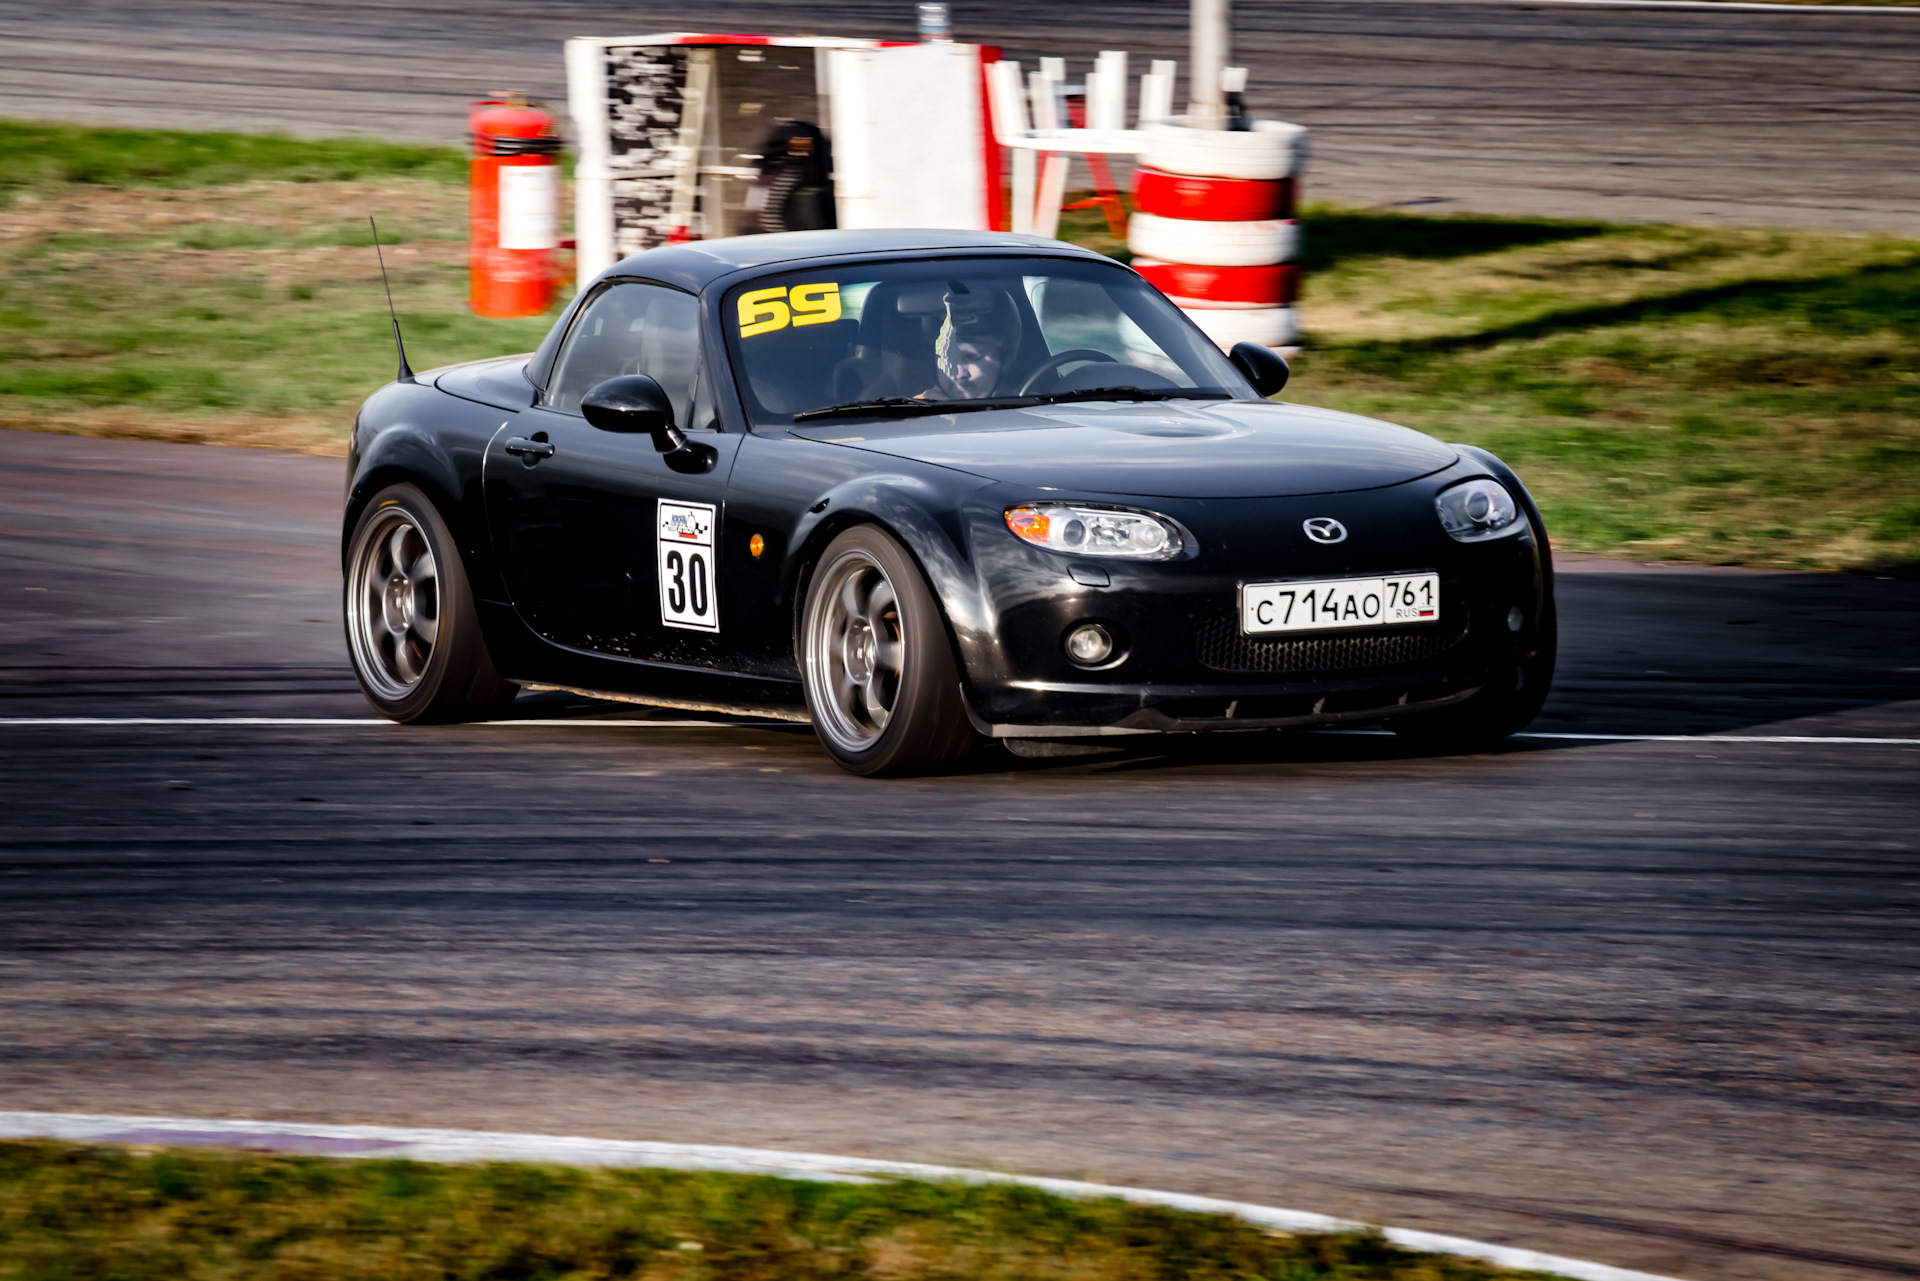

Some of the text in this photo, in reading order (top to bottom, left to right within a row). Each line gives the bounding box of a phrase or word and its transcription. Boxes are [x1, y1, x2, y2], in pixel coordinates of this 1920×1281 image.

[737, 282, 842, 338] 69
[667, 550, 708, 617] 30
[1387, 580, 1432, 607] 761
[1396, 607, 1418, 618] RUS
